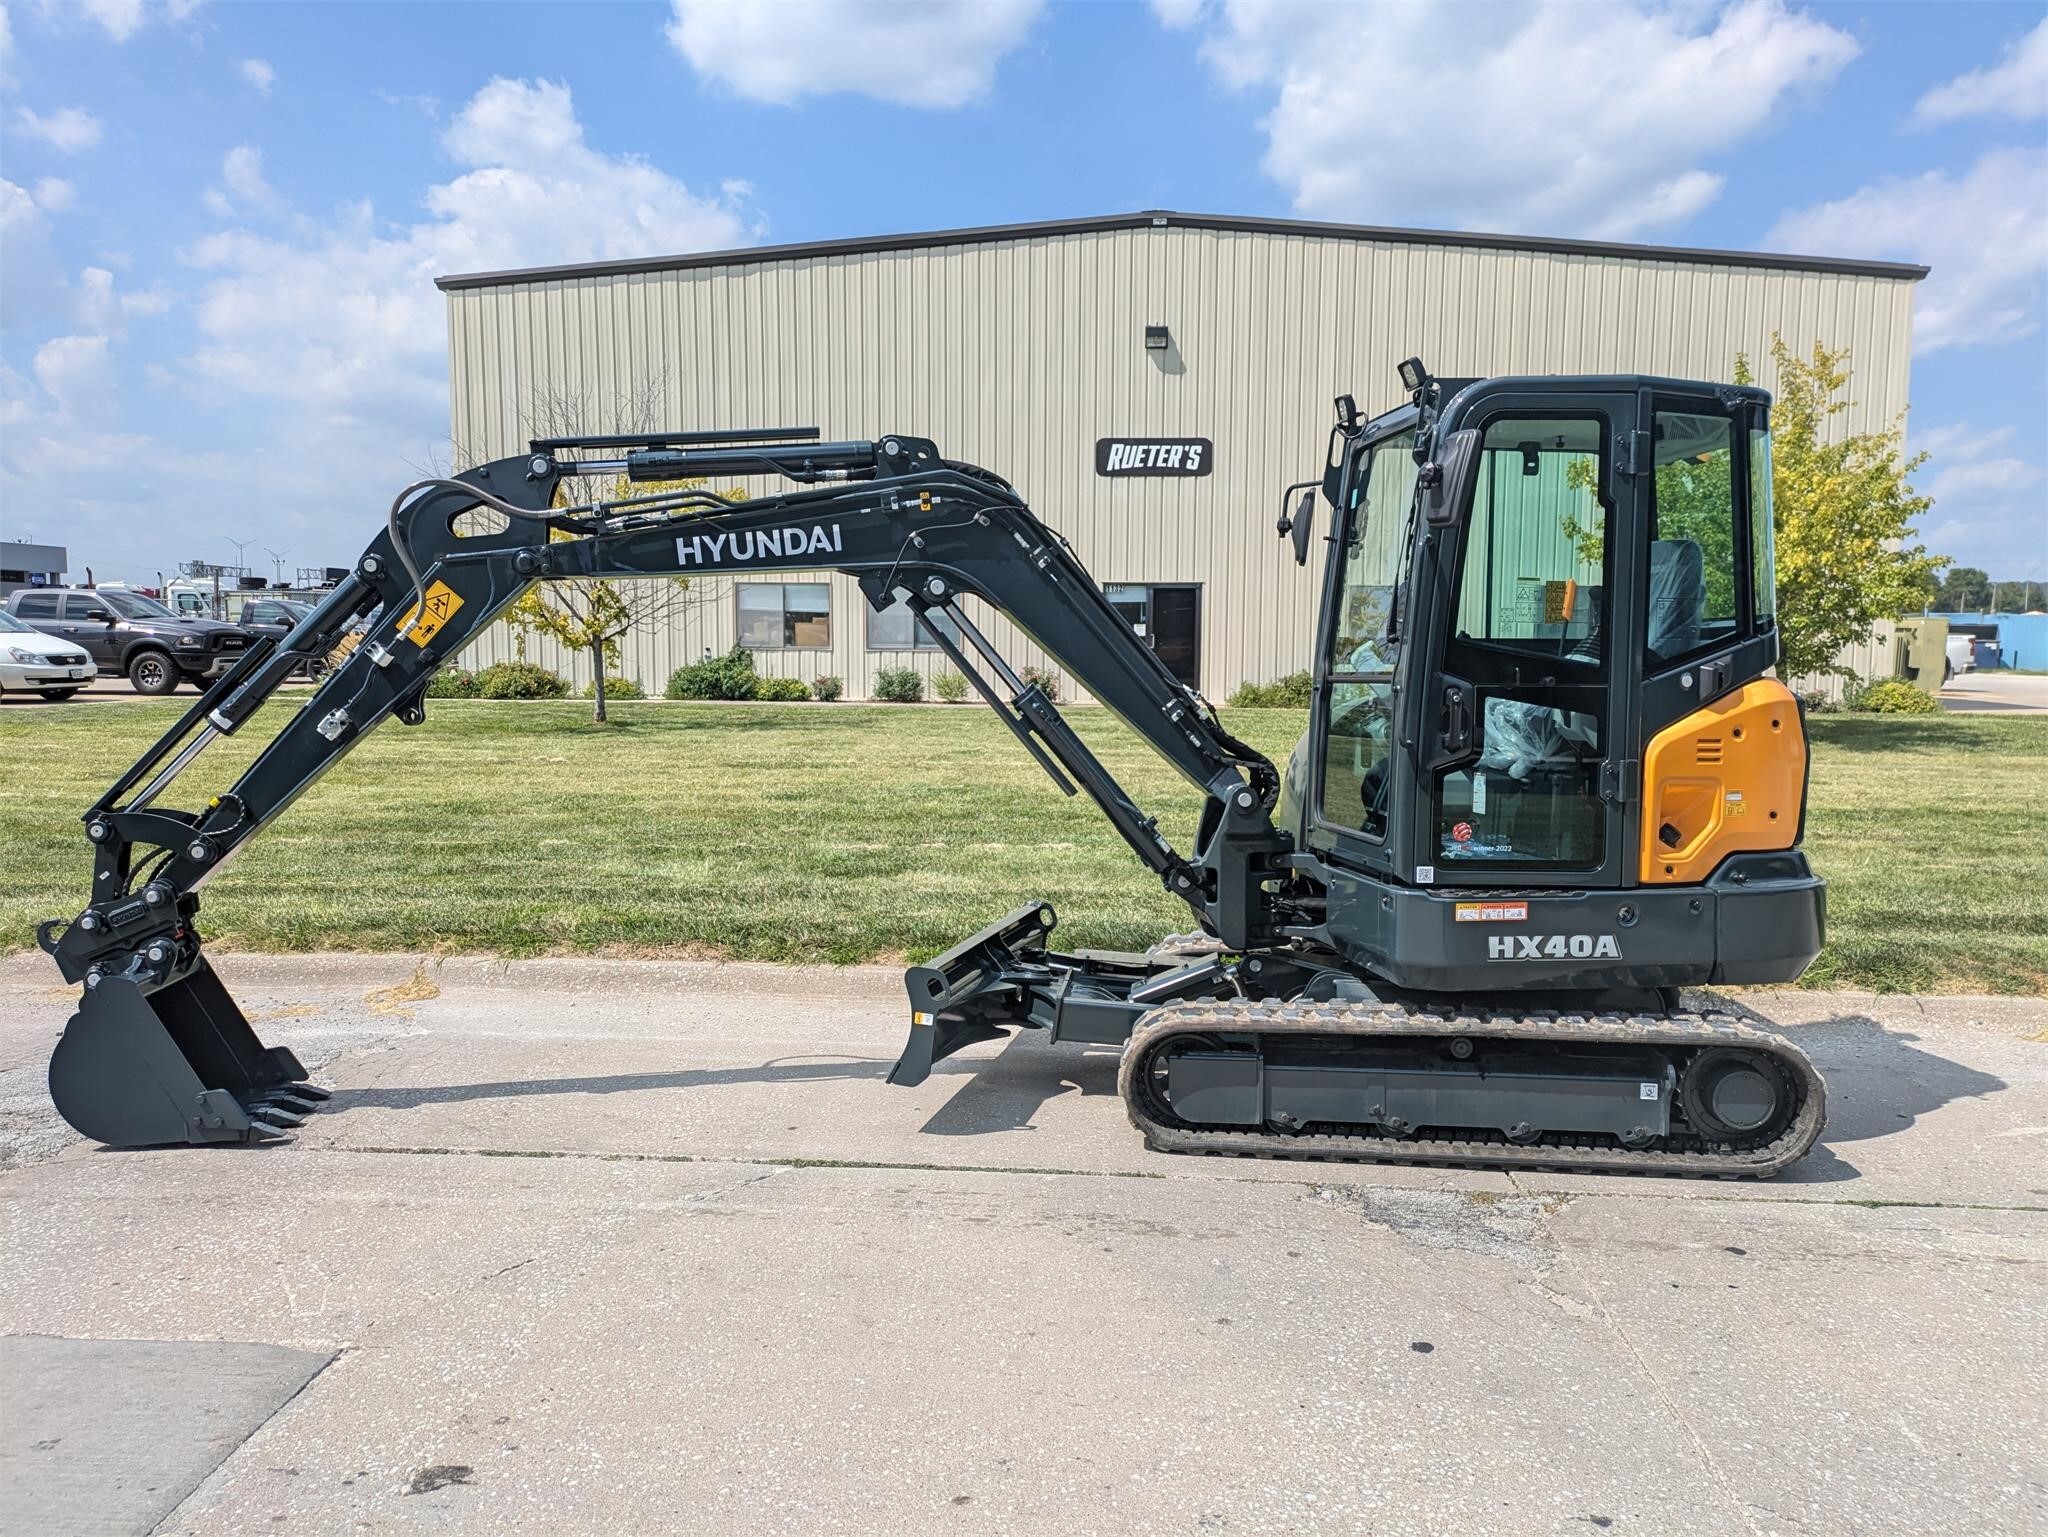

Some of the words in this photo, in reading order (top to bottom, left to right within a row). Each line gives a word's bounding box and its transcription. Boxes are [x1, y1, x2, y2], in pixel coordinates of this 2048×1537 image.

[1106, 443, 1203, 472] RUETER'S
[675, 524, 842, 565] HYUNDAI
[1488, 935, 1620, 959] HX40A
